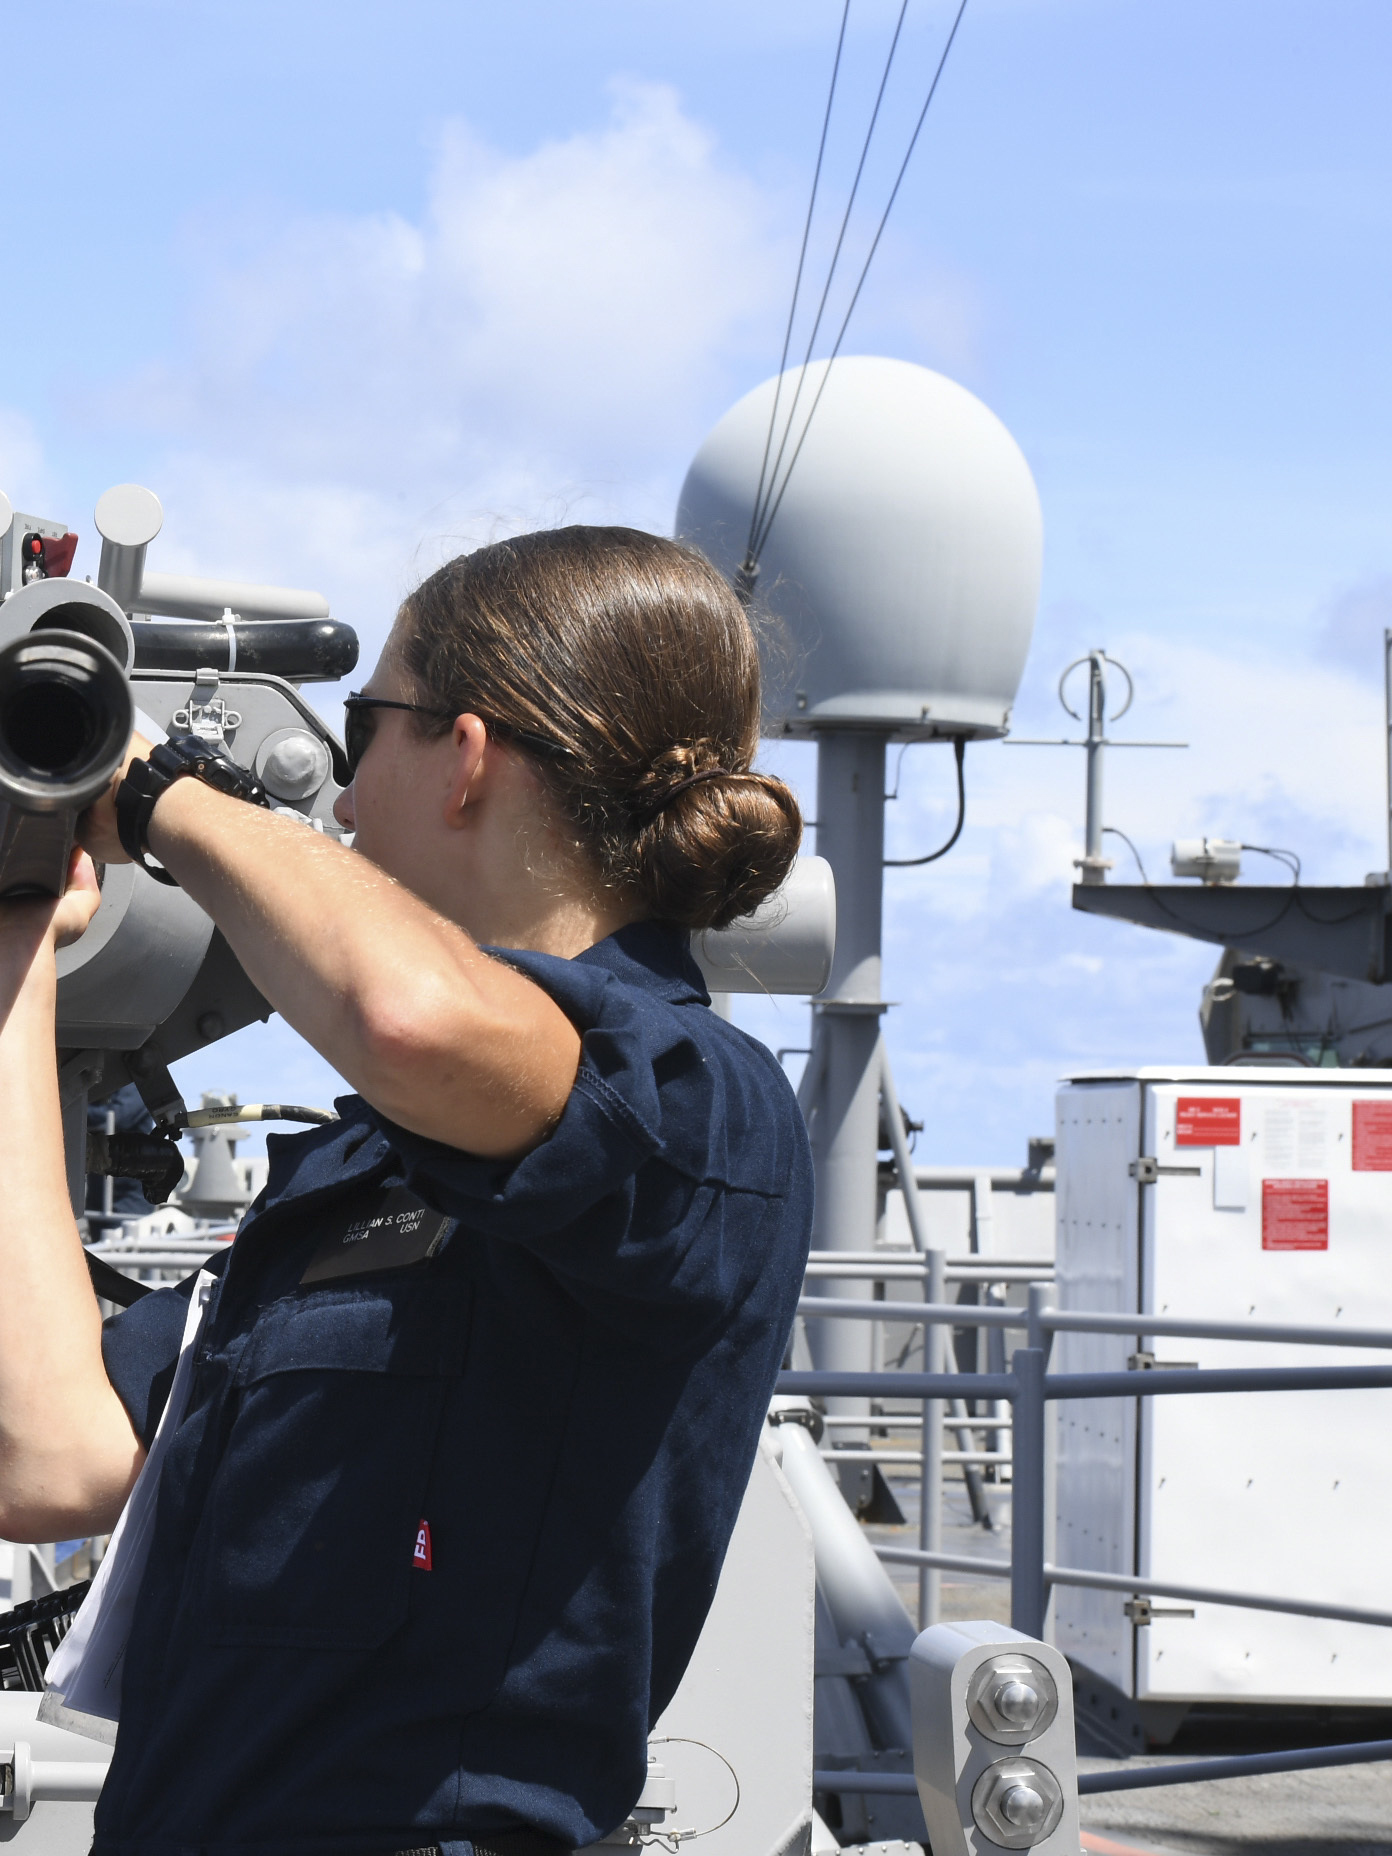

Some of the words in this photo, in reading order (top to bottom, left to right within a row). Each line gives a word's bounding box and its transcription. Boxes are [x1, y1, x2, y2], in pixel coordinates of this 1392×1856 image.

[342, 1229, 370, 1244] GMSA
[399, 1220, 421, 1234] USN
[348, 1217, 384, 1233] LILLIAN
[384, 1215, 393, 1226] S.
[396, 1208, 426, 1225] CONTI
